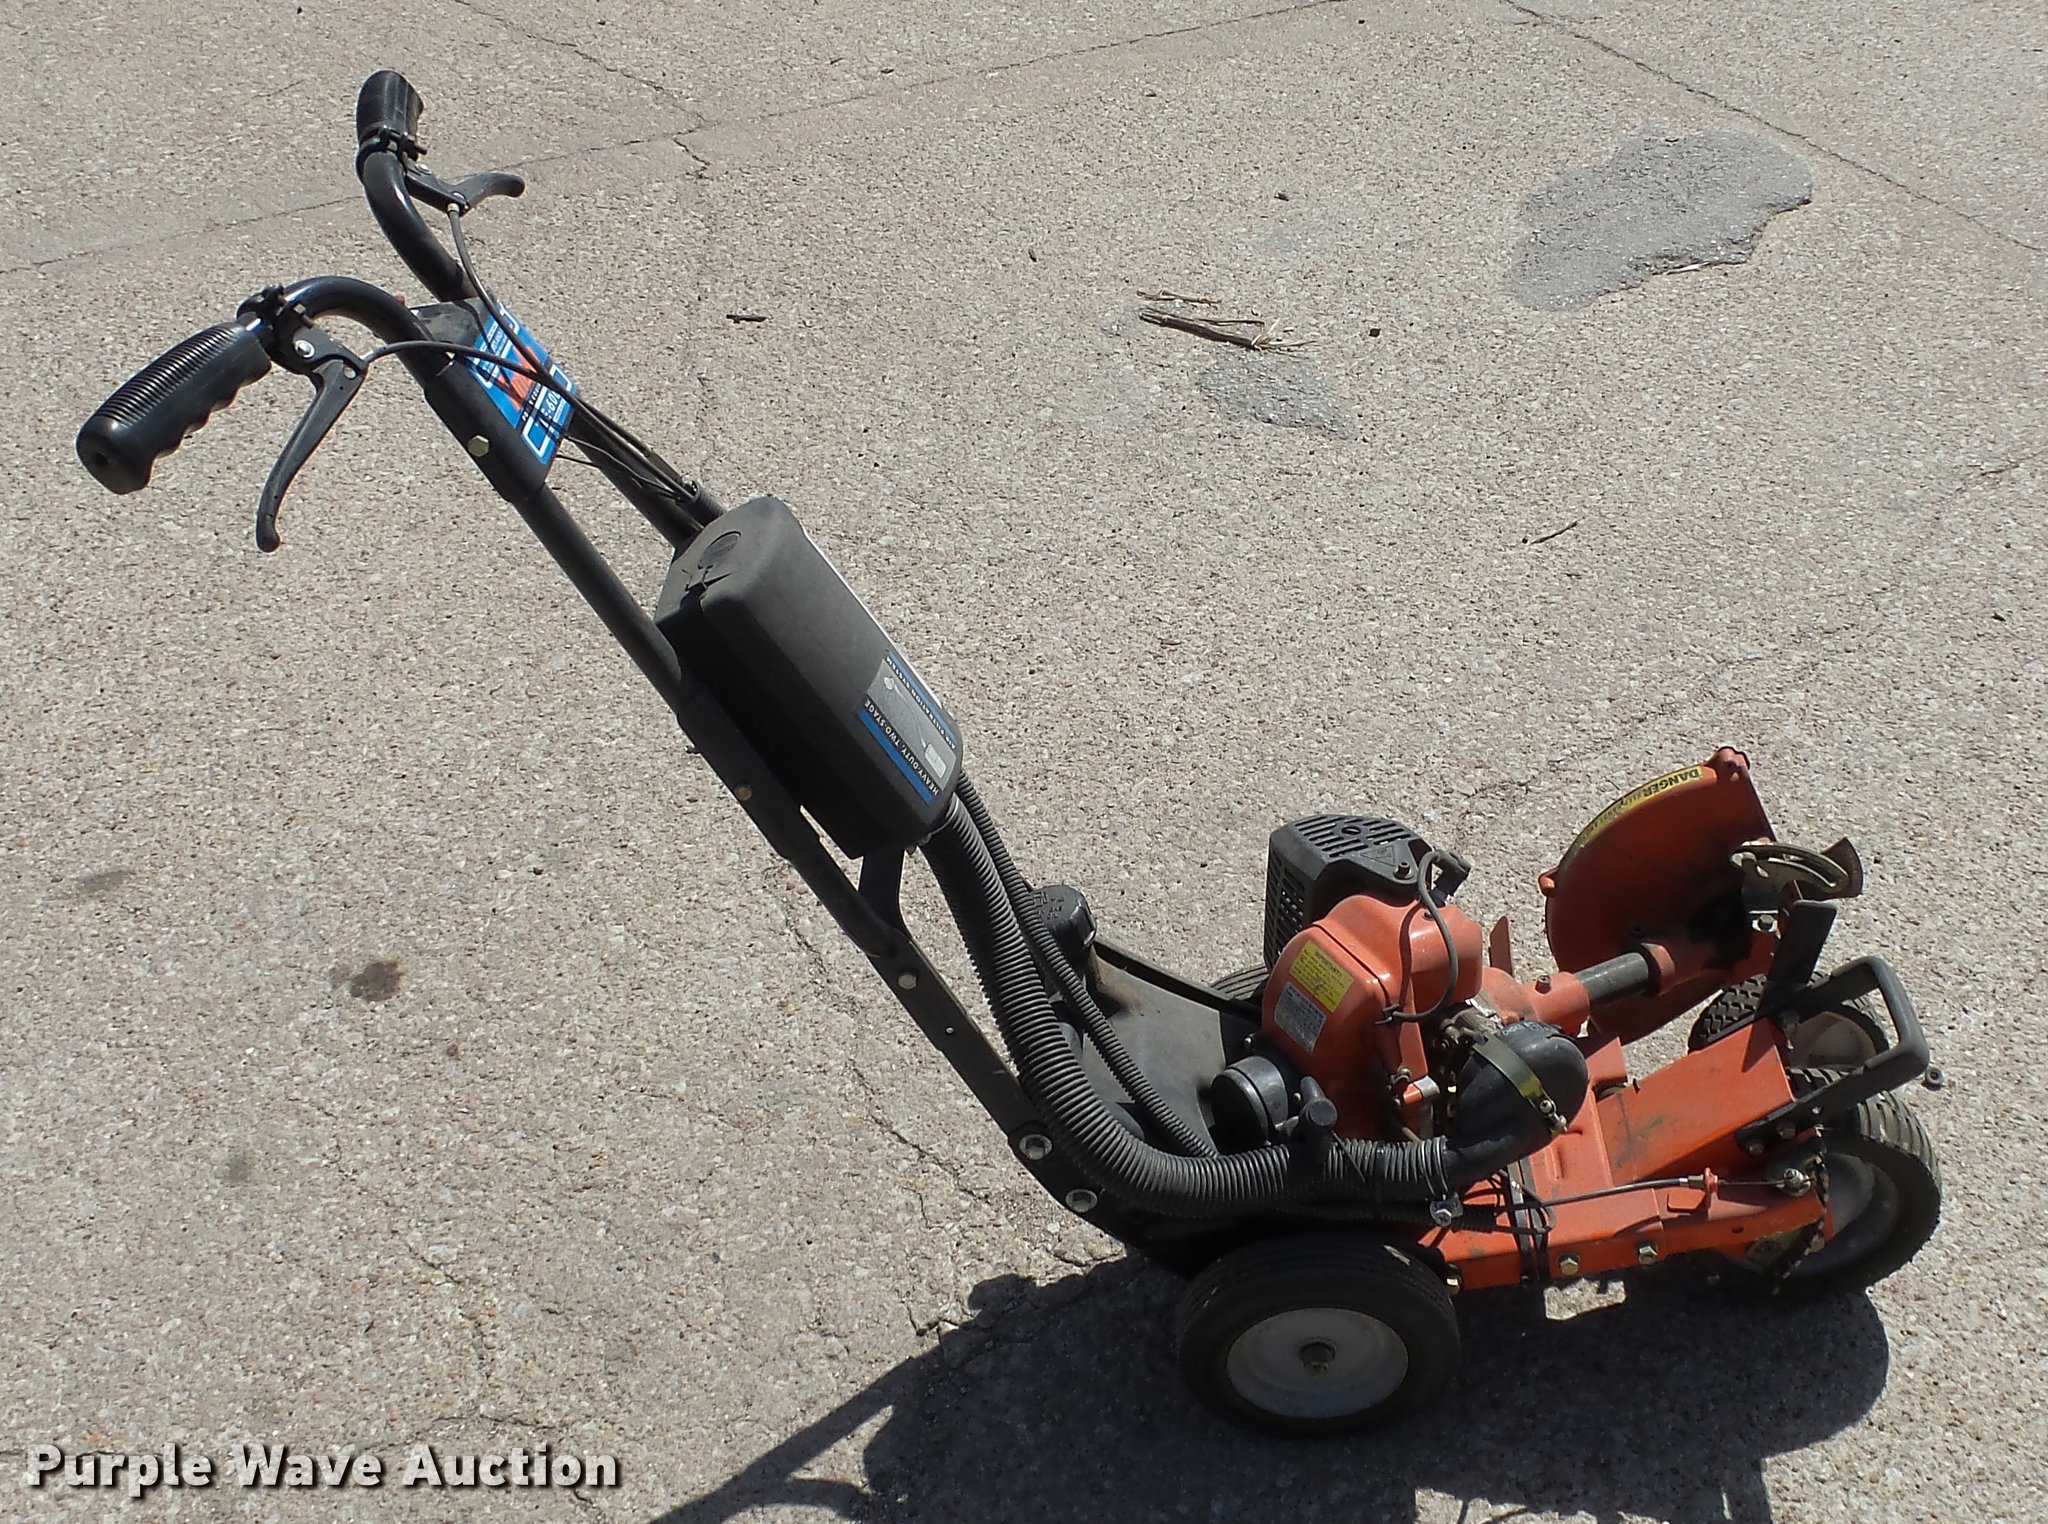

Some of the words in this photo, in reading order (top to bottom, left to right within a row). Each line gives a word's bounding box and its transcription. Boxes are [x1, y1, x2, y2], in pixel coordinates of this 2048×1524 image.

[886, 655, 910, 690] SYSTEM
[863, 697, 901, 747] TWO-STAGE
[909, 687, 945, 736] FILTRATION
[944, 733, 956, 750] AIR
[1642, 769, 1700, 797] DANGER
